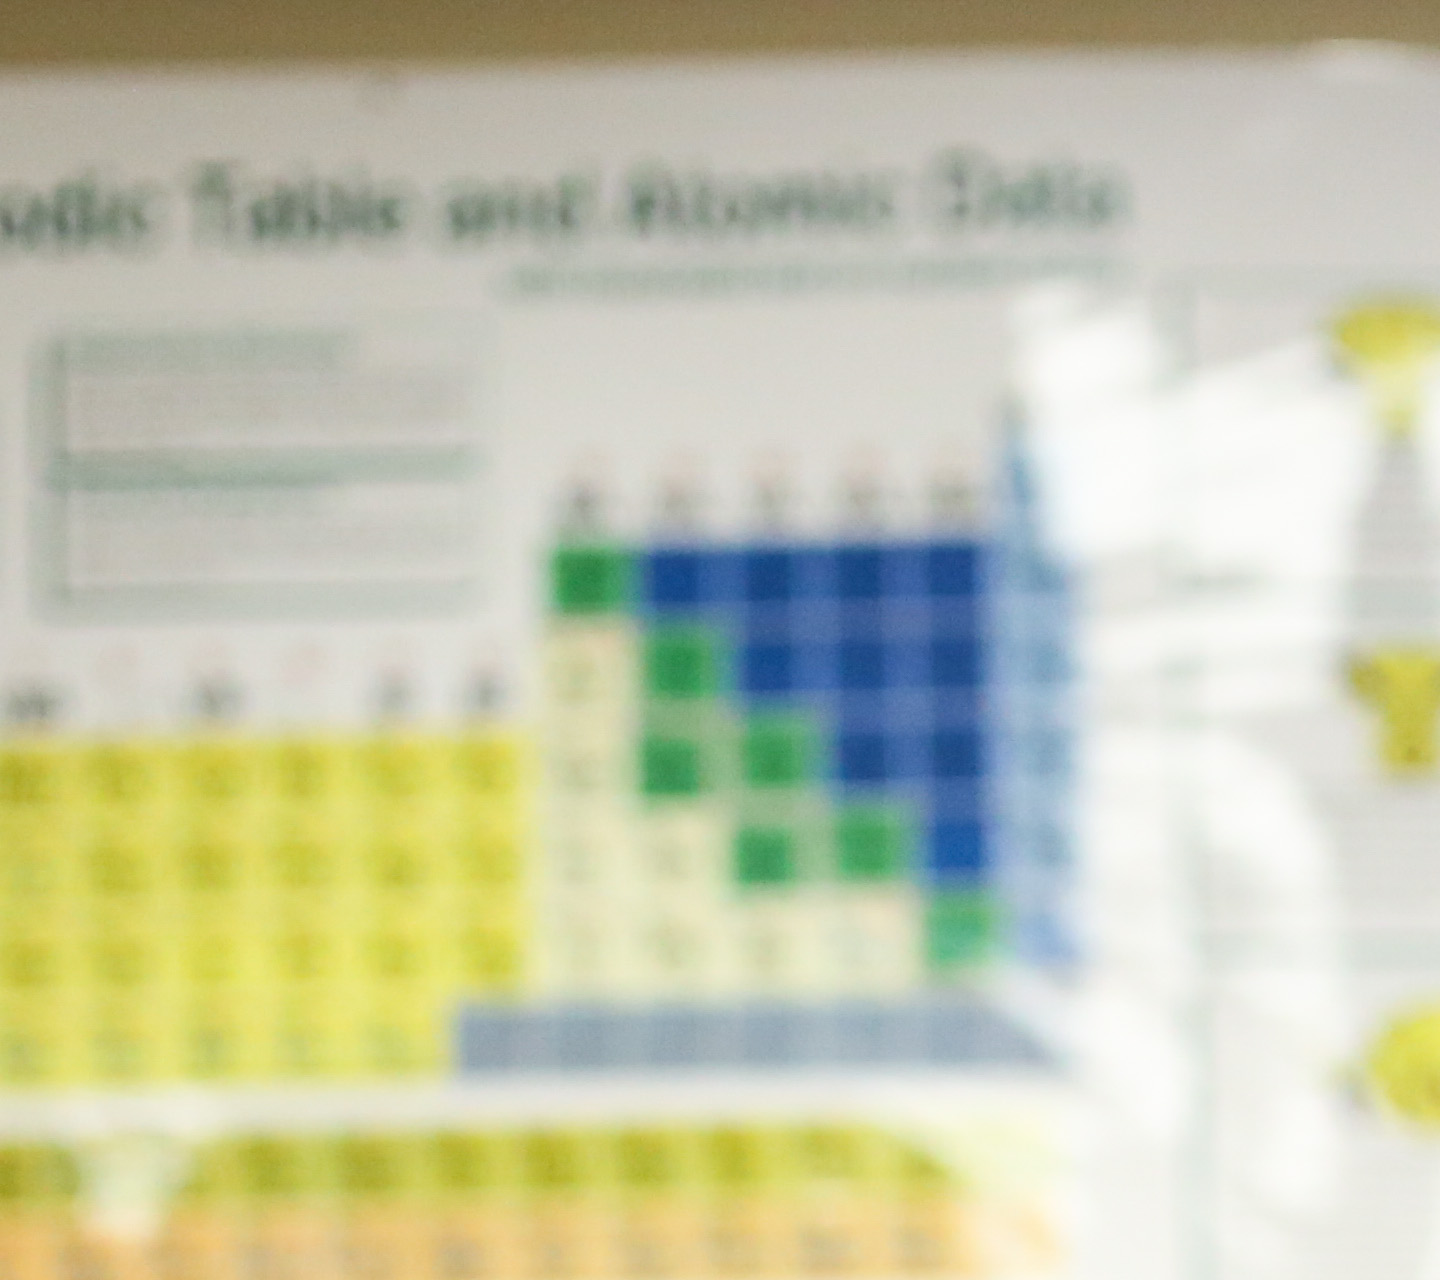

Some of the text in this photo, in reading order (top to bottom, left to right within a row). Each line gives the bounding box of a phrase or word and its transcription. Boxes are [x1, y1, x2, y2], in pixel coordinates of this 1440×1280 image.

[190, 162, 403, 250] Table
[440, 162, 596, 245] and
[624, 152, 896, 240] Atomic
[926, 146, 1134, 232] Data
